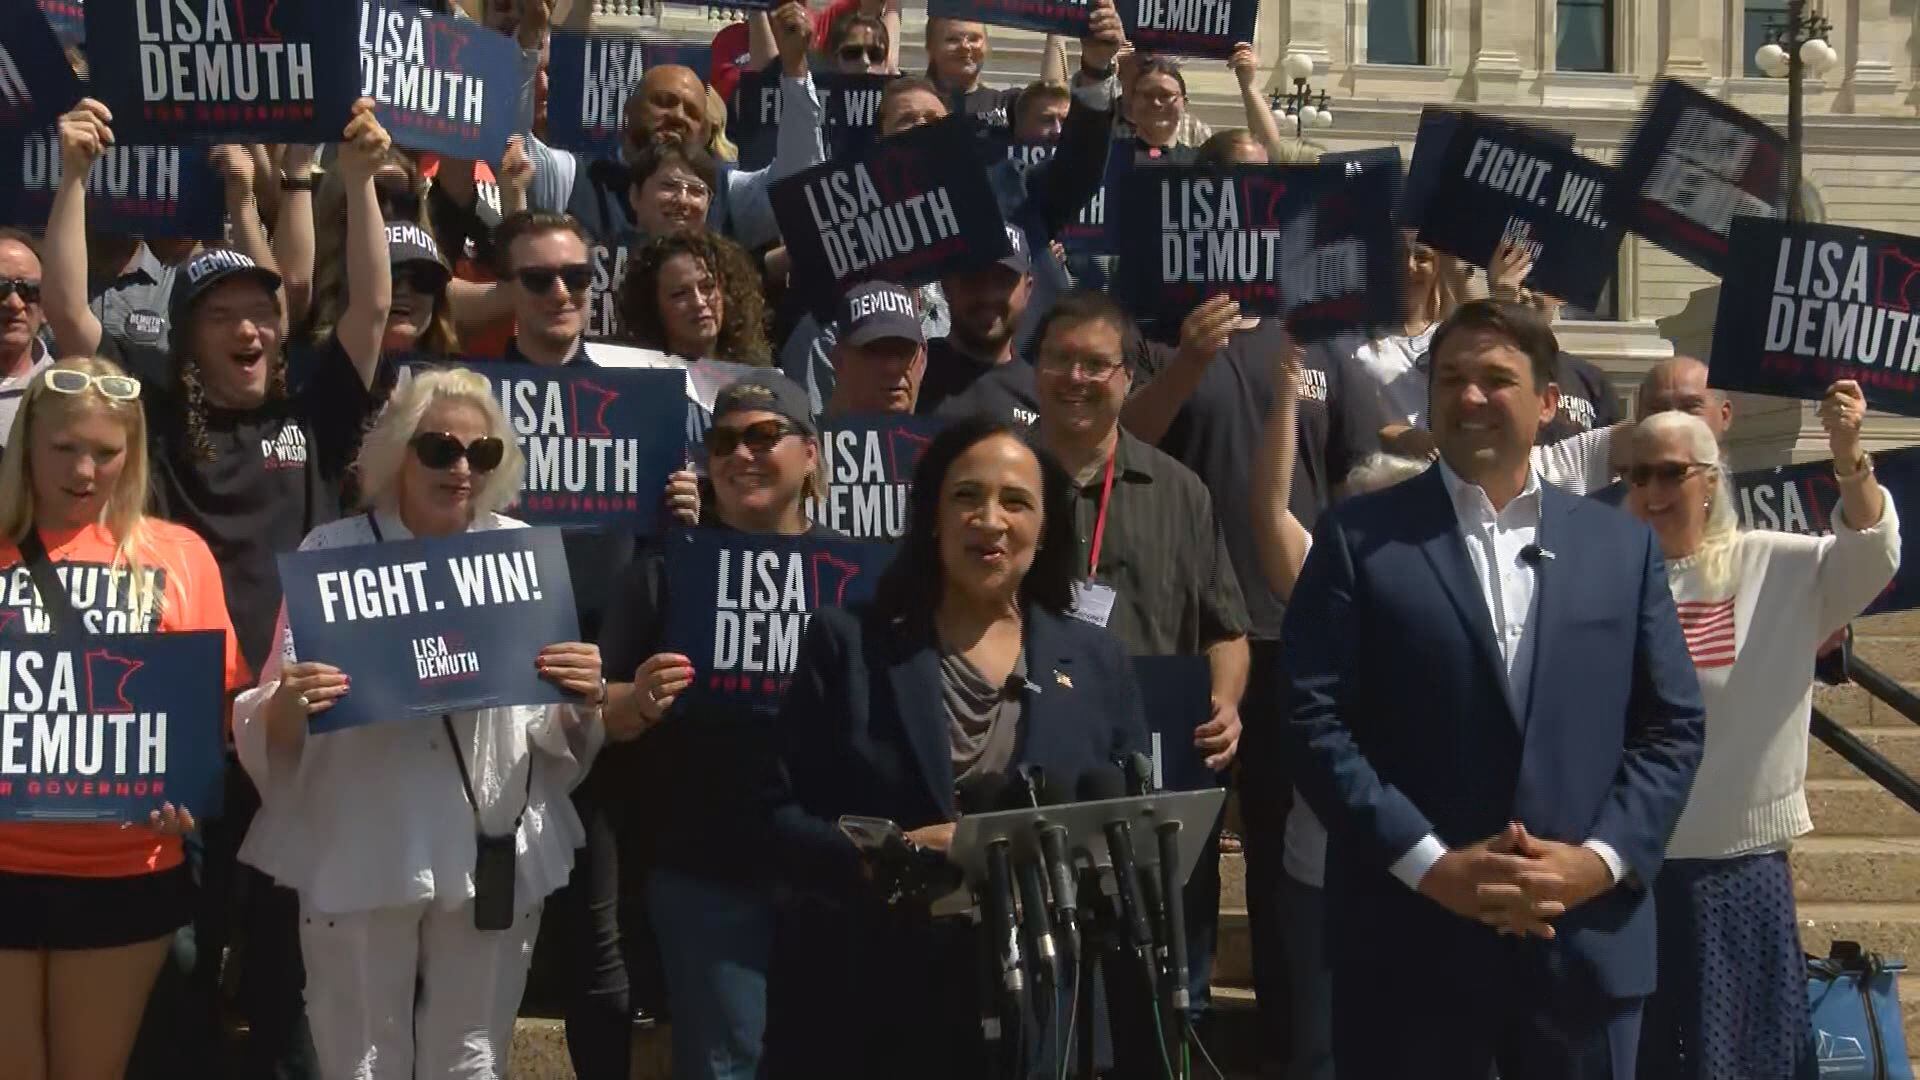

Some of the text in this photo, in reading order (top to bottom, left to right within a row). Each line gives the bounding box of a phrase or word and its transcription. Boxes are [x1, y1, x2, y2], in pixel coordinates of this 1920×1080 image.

[136, 0, 232, 42] LISA
[359, 2, 425, 66] LISA
[1138, 0, 1231, 34] DEMUTH
[139, 43, 314, 101] DEMUTH
[760, 87, 836, 127] FIT.
[23, 127, 179, 201] DUTH
[1464, 136, 1553, 206] FIGHT.
[803, 163, 882, 231] LISA
[1162, 178, 1239, 230] LISA
[820, 187, 960, 279] DEMUTH
[1162, 230, 1281, 282] DEMUT
[1774, 237, 1869, 304] LISA
[850, 289, 914, 323] DEMUTH
[1764, 295, 1920, 373] DEMUTH
[501, 379, 566, 436] ISA
[516, 436, 638, 494] MUTH
[824, 430, 886, 484] ISA
[805, 484, 906, 537] EMU
[1740, 481, 1809, 533] ISA
[0, 565, 156, 610] EUTH
[317, 551, 544, 623] FIGHT. WIN!
[717, 549, 807, 613] LISA
[412, 636, 448, 660] LISA
[416, 651, 481, 680] DEMUTH
[713, 611, 813, 673] DEM
[0, 650, 78, 713] ISA
[0, 712, 168, 776] EMUTH
[27, 780, 165, 797] GOVERNOR
